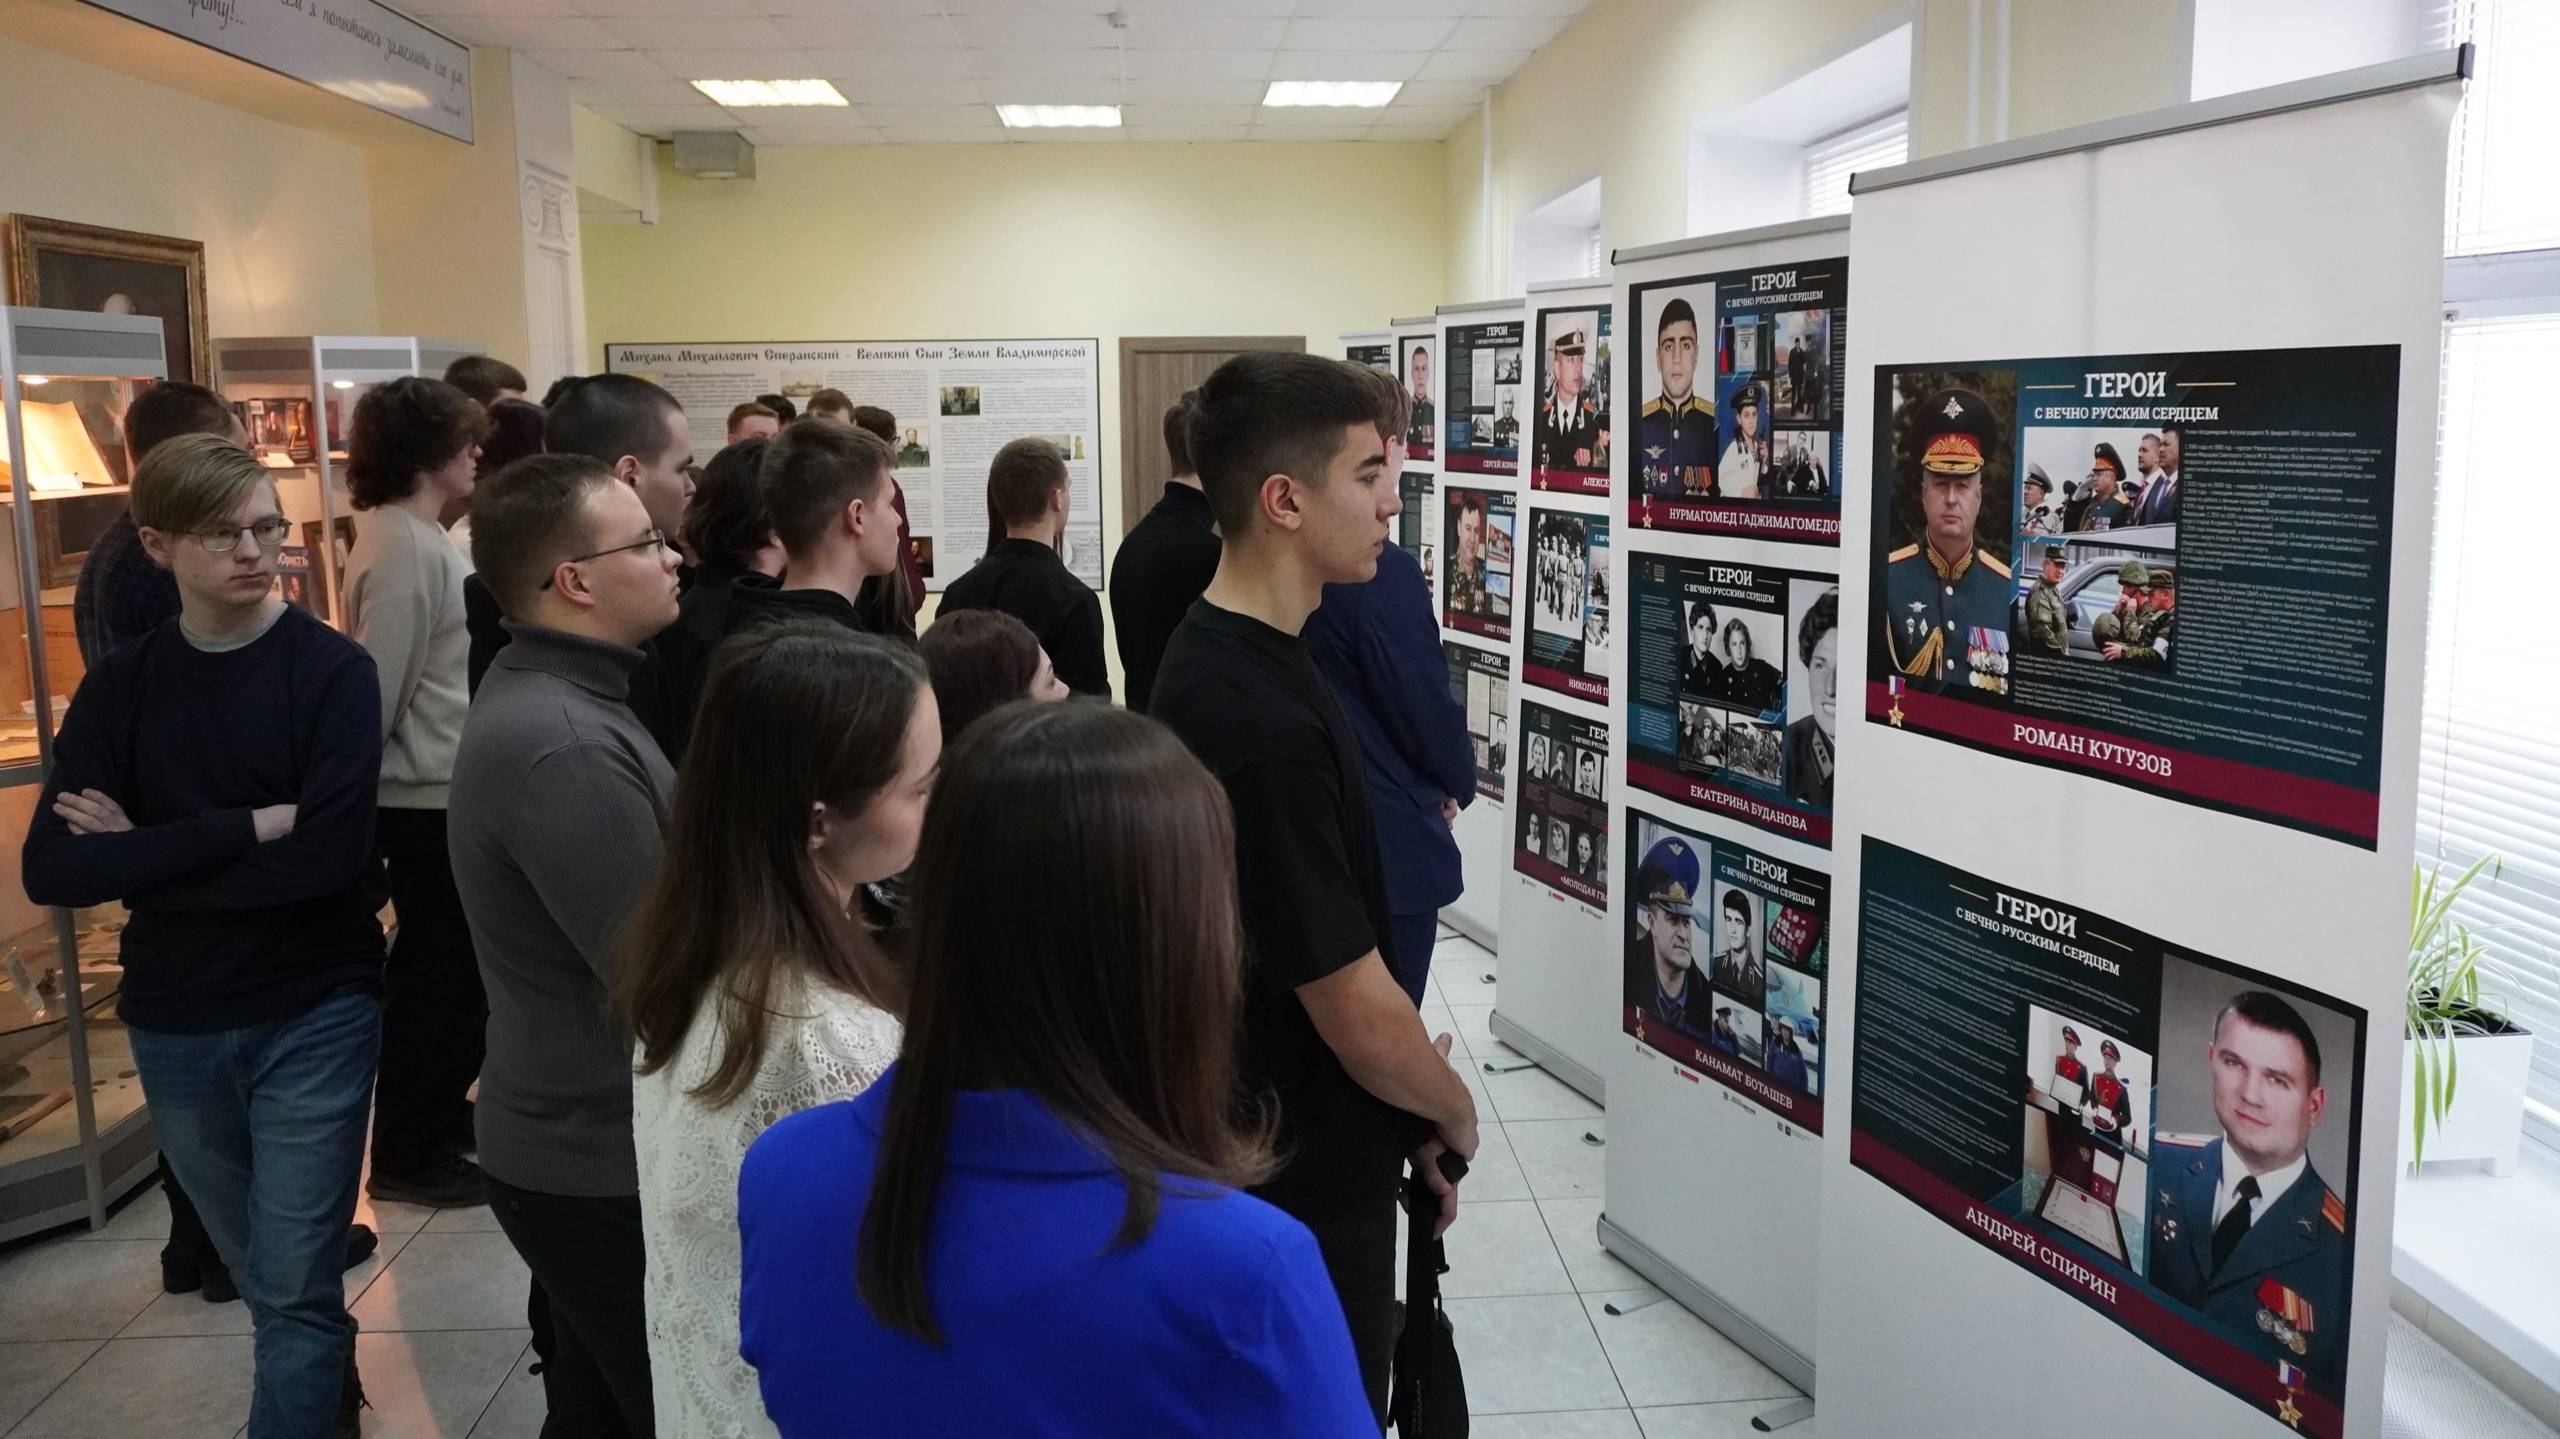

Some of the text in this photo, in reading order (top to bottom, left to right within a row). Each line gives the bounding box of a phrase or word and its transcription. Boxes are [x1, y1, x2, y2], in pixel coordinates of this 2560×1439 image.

[1751, 270, 1797, 292] ГЕРОИ
[1726, 290, 1823, 308] С ВЕЧНО РУССКИМ СЕРДЦЕМ
[1487, 325, 1508, 336] ГЕРОИ
[620, 349, 671, 364] Михаил
[678, 348, 758, 364] Михайлович
[764, 348, 839, 364] Сперанский
[857, 347, 910, 361] Великий
[916, 347, 943, 360] Сын
[949, 346, 990, 361] Земли
[996, 345, 1086, 361] Владимирской
[2084, 371, 2166, 398] ГЕРОИ
[2034, 406, 2219, 423] С ВЕЧНО РУССКИМ СЕРДЦЕМ
[1669, 508, 1737, 526] НУРМАГОМЕД
[1708, 566, 1753, 587] ГЕРОИ
[1684, 583, 1775, 604] С ВЕЧНО РУССКИМ СЕРДЦЕМ
[1481, 652, 1501, 667] ГЕРОИ
[1568, 678, 1602, 695] НИКОЛАЙ
[2013, 723, 2172, 777] РОМАН КУТУЗОВ
[1690, 785, 1808, 831] ЕКАТЕРИНА БУДАНОВА
[1745, 854, 1788, 884] ГЕРОИ
[1560, 875, 1596, 898] «МОЛОДАЯ
[1721, 865, 1816, 907] С ВЕЧНО РУССКИМ СЕРДЦЕМ
[1995, 892, 2077, 939] ГЕРОИ
[1956, 907, 2121, 976] С ВЕЧНО РУССКИМ СЕРДЦЕМ
[1695, 1049, 1744, 1083] КАНАМАТ
[1745, 1073, 1793, 1110] БОТАШЕВ
[1965, 1207, 2117, 1304] АНДРЕЙ СПИРИН
